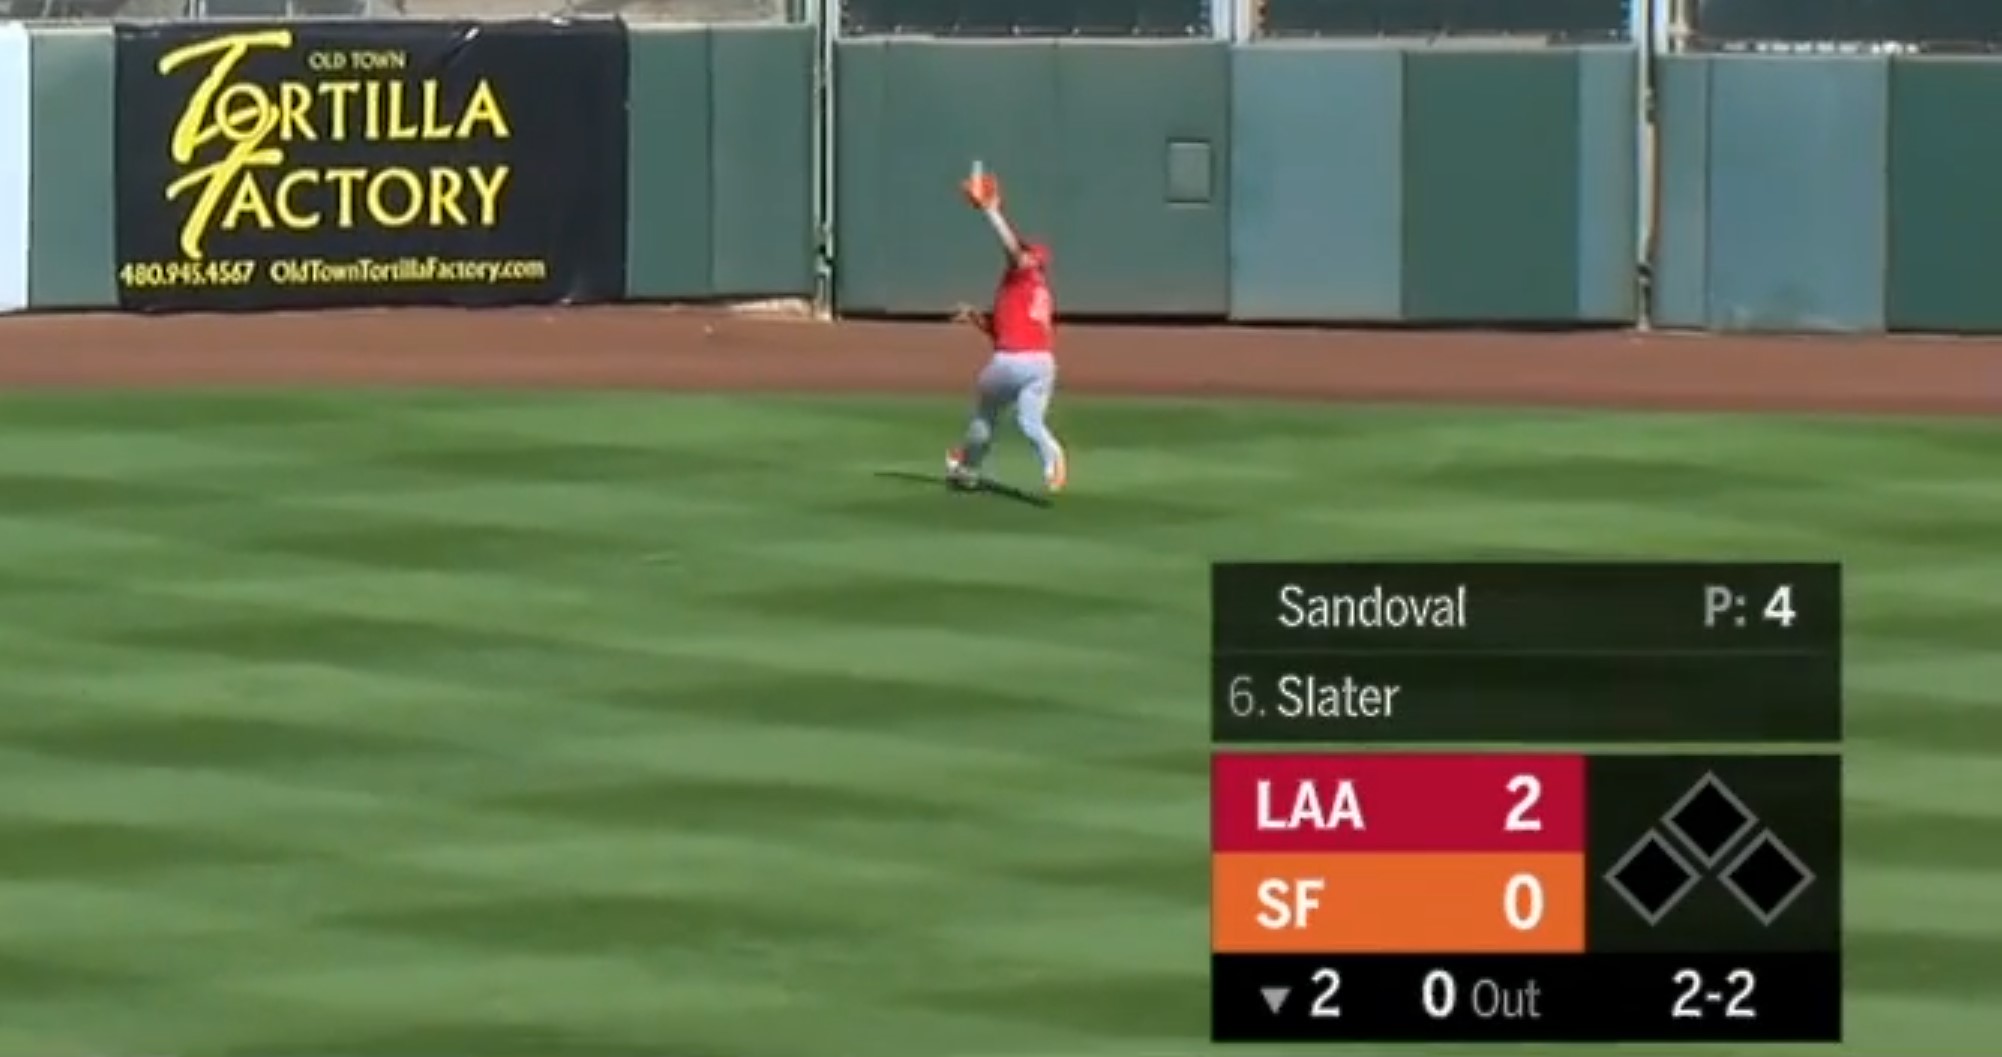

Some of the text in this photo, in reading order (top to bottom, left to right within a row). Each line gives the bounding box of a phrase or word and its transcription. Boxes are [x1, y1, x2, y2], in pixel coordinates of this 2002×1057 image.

[159, 30, 510, 164] TORTILLA
[309, 51, 405, 69] OLD TOWN
[166, 105, 508, 258] FACTORY
[120, 257, 545, 286] 480.945.4567 OldTownTortillaFactory.com
